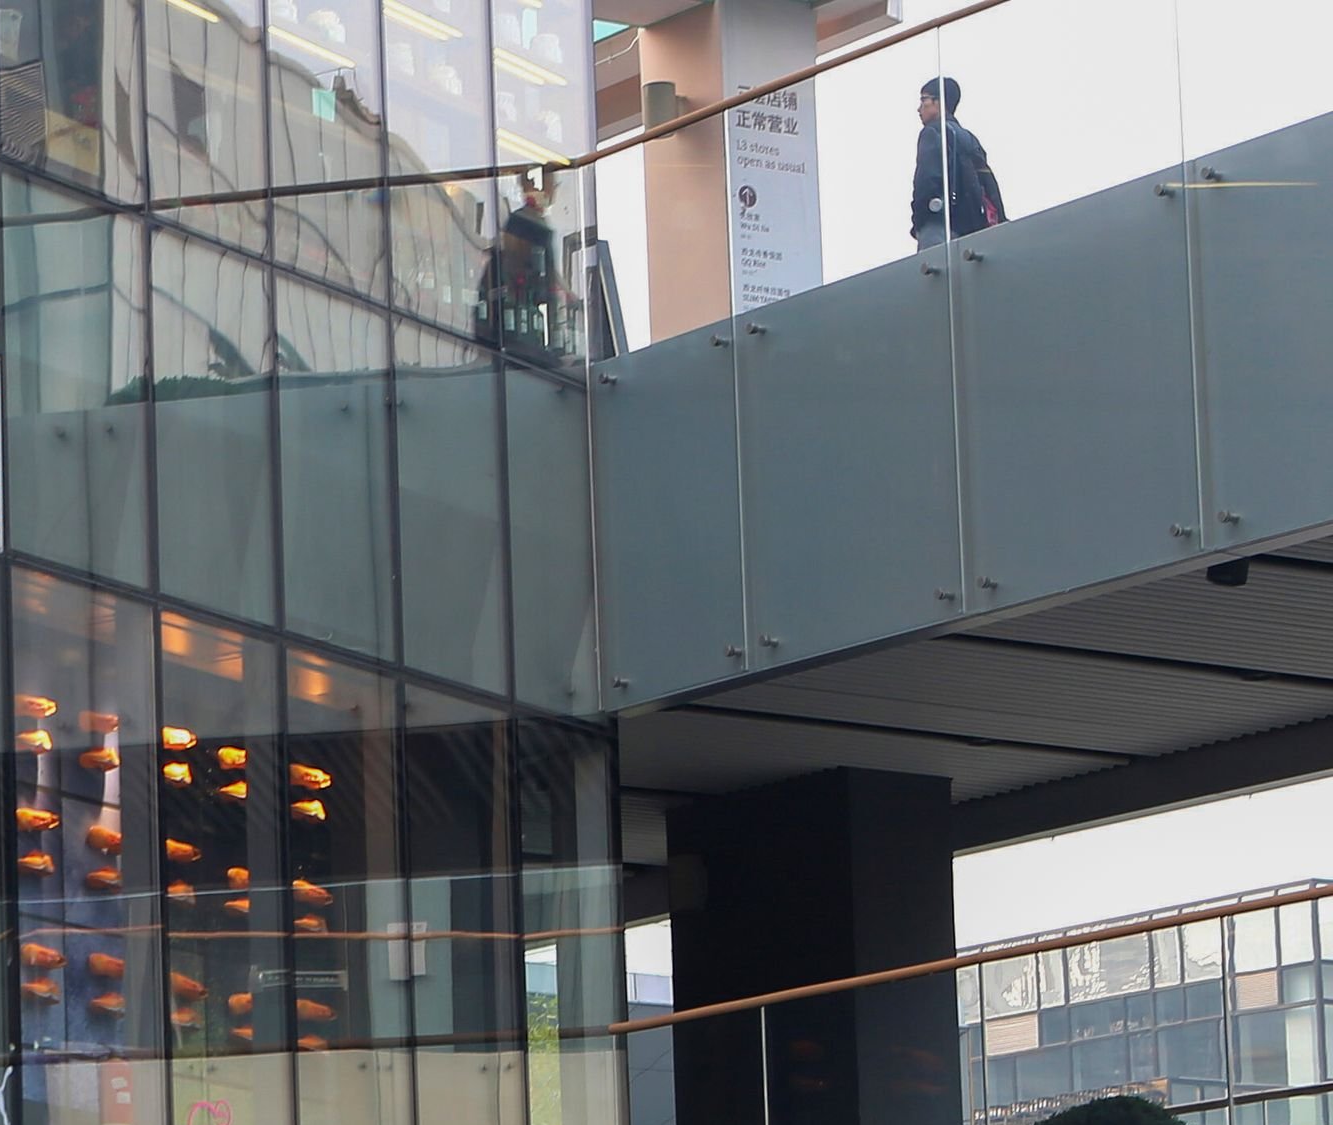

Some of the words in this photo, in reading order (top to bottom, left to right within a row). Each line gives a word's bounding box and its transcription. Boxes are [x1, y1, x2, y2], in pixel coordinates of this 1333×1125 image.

[736, 109, 799, 135] 正常营业
[750, 142, 780, 156] stores
[737, 156, 762, 168] open
[764, 160, 777, 170] as
[778, 162, 806, 174] usual
